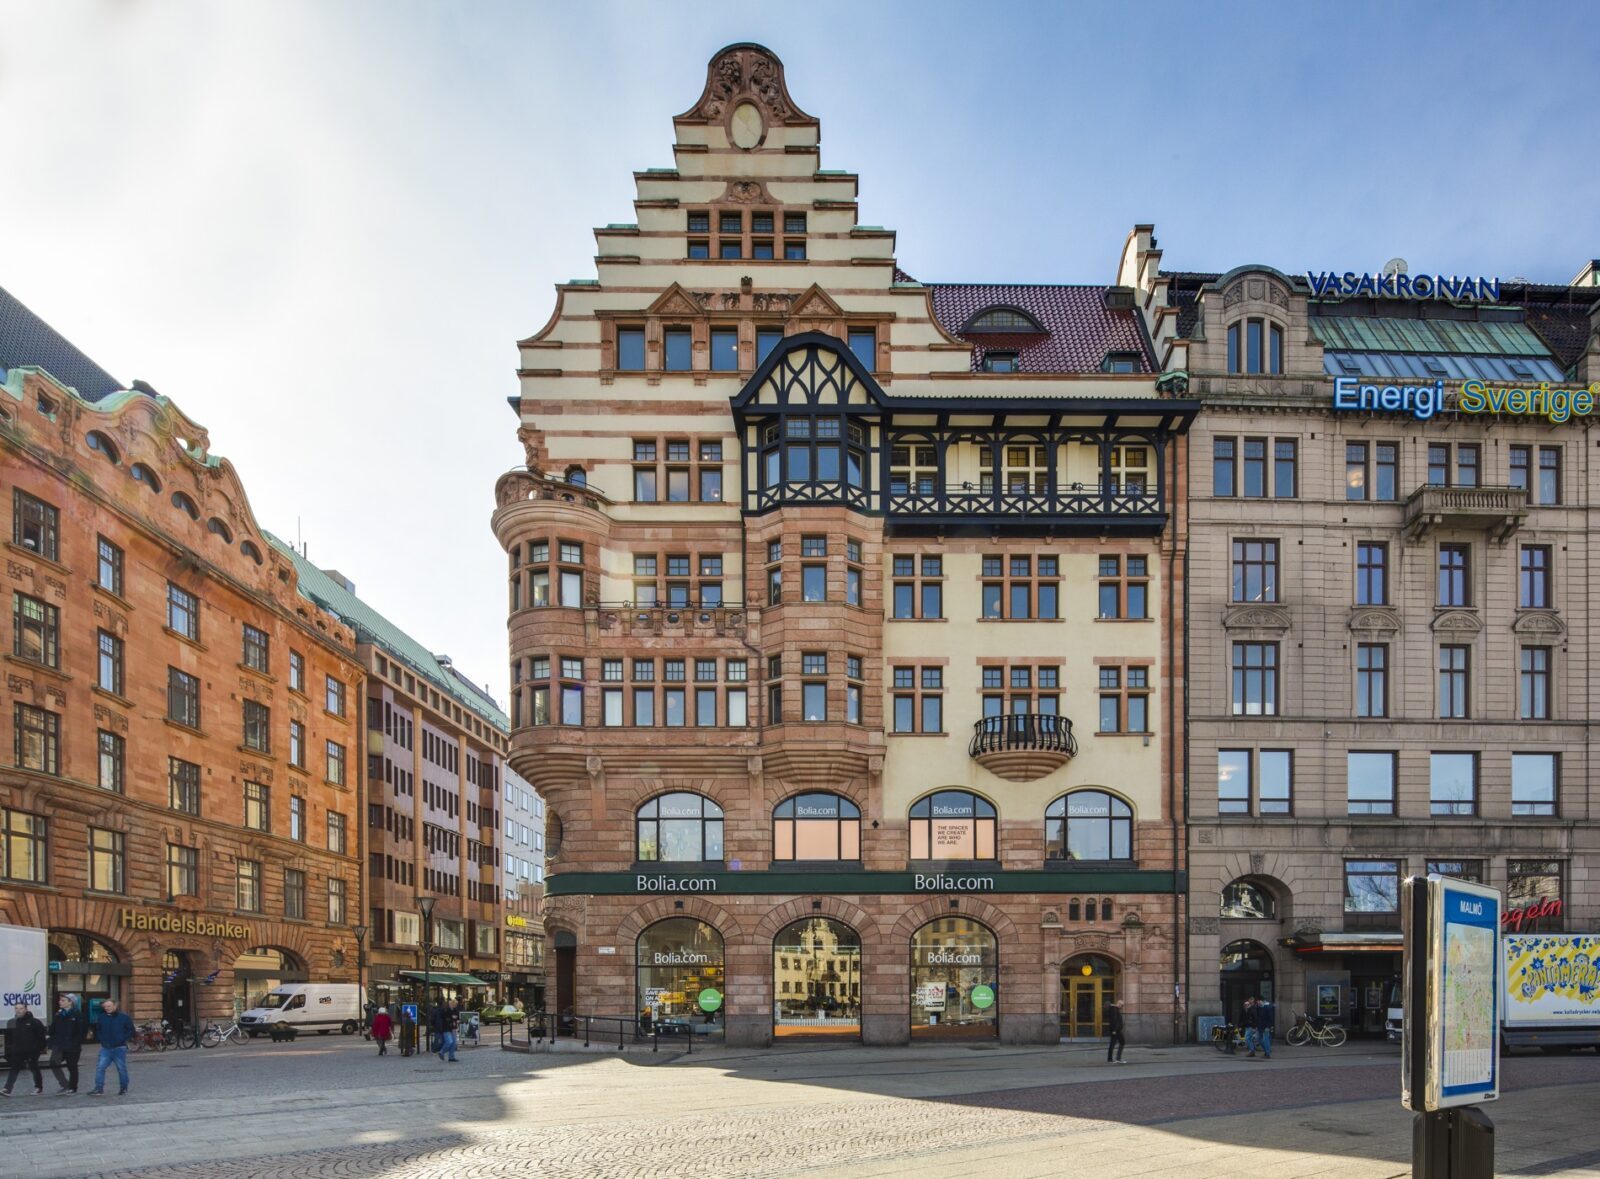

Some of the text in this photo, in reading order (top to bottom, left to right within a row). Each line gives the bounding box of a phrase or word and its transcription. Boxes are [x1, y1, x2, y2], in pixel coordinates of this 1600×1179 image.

[1307, 271, 1500, 300] VASAKRONAN
[1334, 377, 1594, 424] Energi Sverige
[661, 807, 701, 816] Bolia.com
[797, 806, 836, 815] Bolia.com
[933, 805, 972, 815] Bolia.com
[1069, 805, 1108, 814] Bolia.com
[636, 875, 717, 891] Bolia.com
[915, 874, 994, 890] Bolia.com
[1459, 900, 1483, 917] MALMÖ
[1500, 896, 1563, 932] egeln
[121, 908, 252, 939] Handelsbanken
[654, 952, 708, 964] Bolia.com
[927, 951, 981, 964] Bolia.com
[3, 993, 41, 1006] servera
